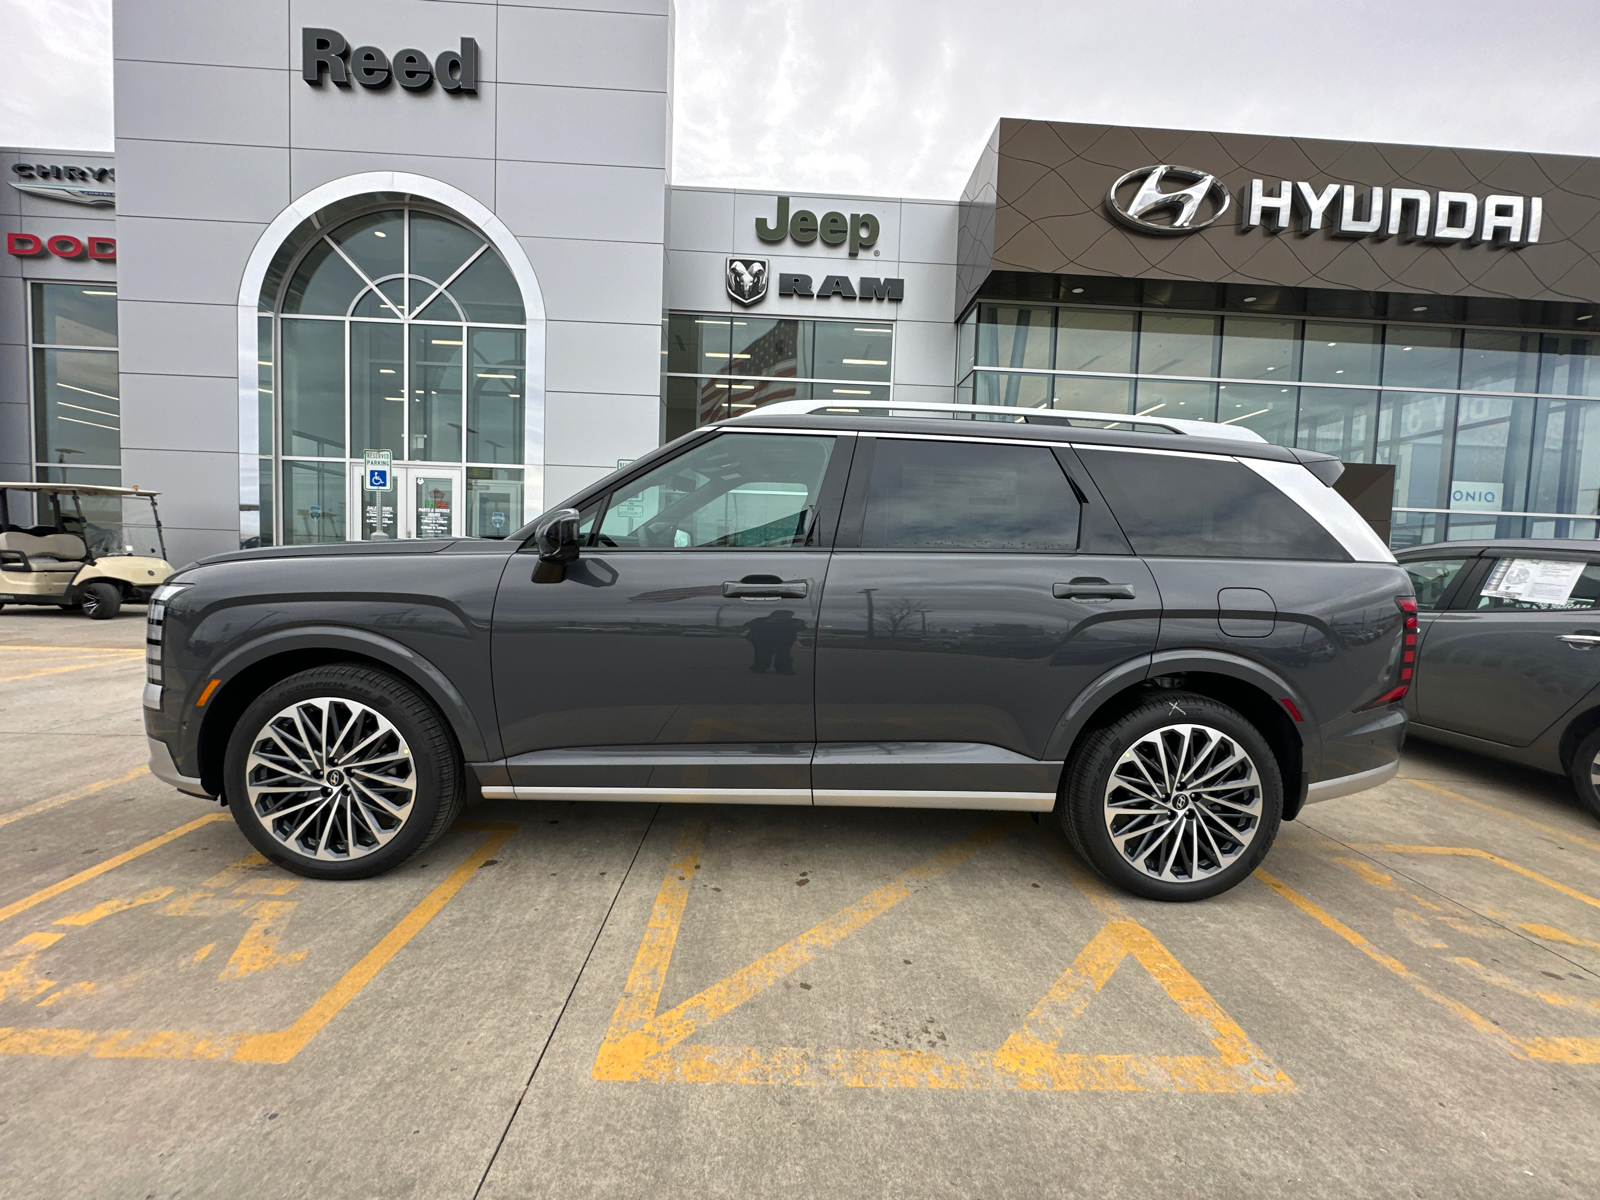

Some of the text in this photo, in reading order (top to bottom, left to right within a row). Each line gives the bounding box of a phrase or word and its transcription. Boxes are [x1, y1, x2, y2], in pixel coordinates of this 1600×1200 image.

[302, 27, 478, 93] Reed
[1248, 179, 1543, 243] HYUNDAI
[755, 197, 880, 256] Jeep
[7, 233, 116, 259] DOD
[779, 273, 904, 302] RAM
[366, 452, 390, 460] RESERVED
[279, 681, 348, 698] SCORPION
